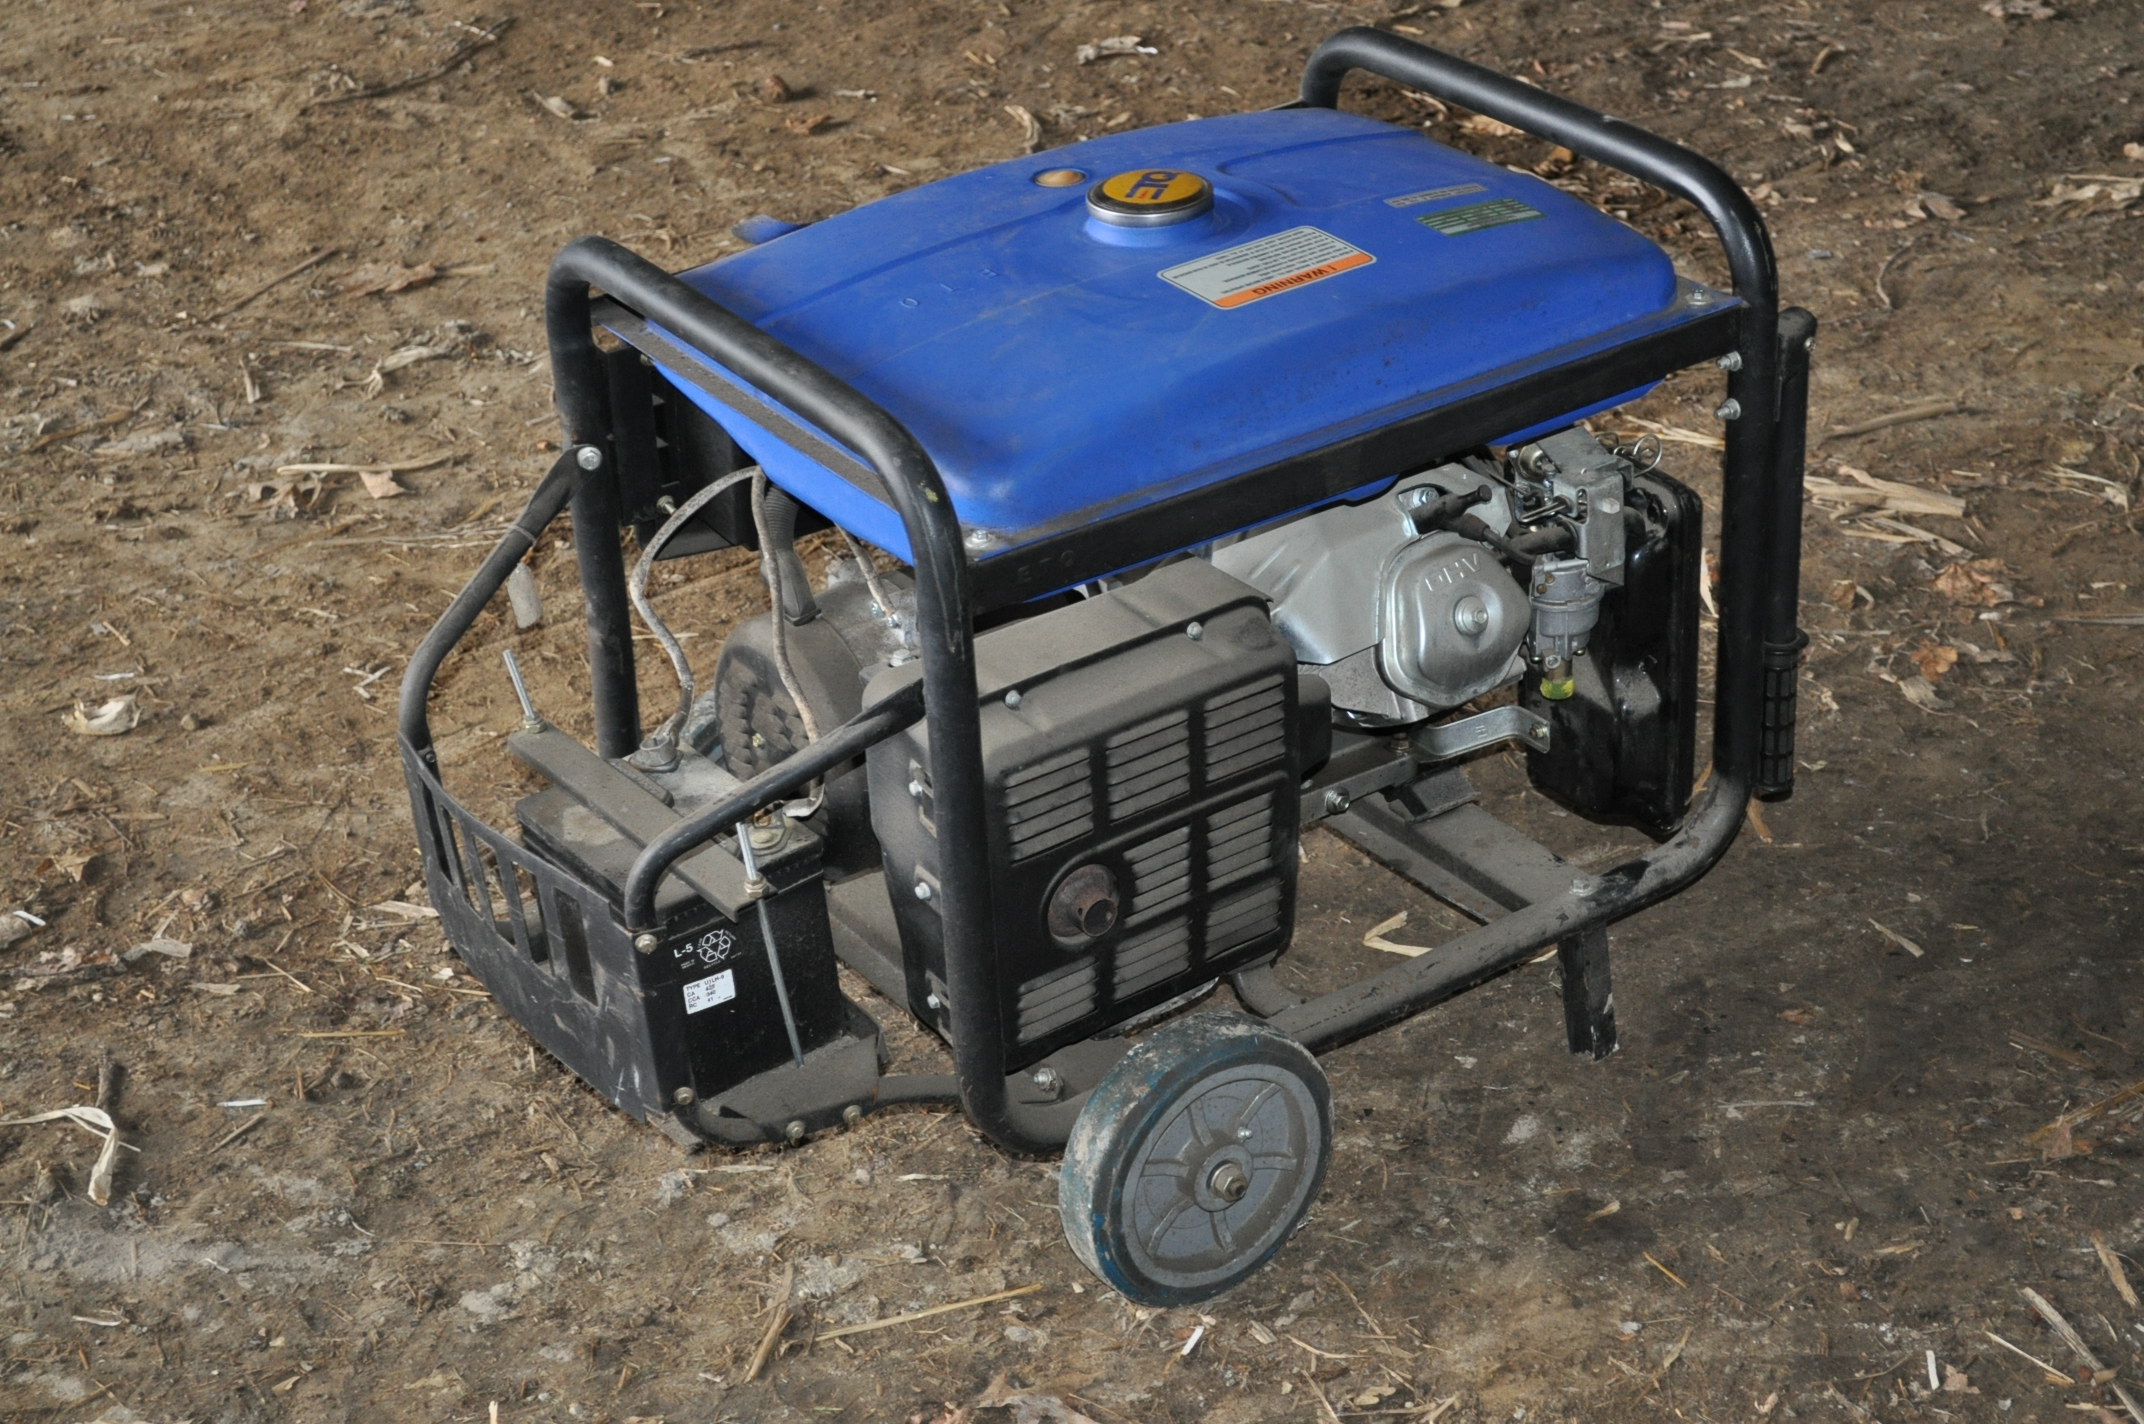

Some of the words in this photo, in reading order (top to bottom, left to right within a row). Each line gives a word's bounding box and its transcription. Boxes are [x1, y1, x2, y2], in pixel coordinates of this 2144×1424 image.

[1252, 266, 1328, 295] WARNING
[673, 943, 694, 958] L-5
[686, 983, 701, 991] TYPE
